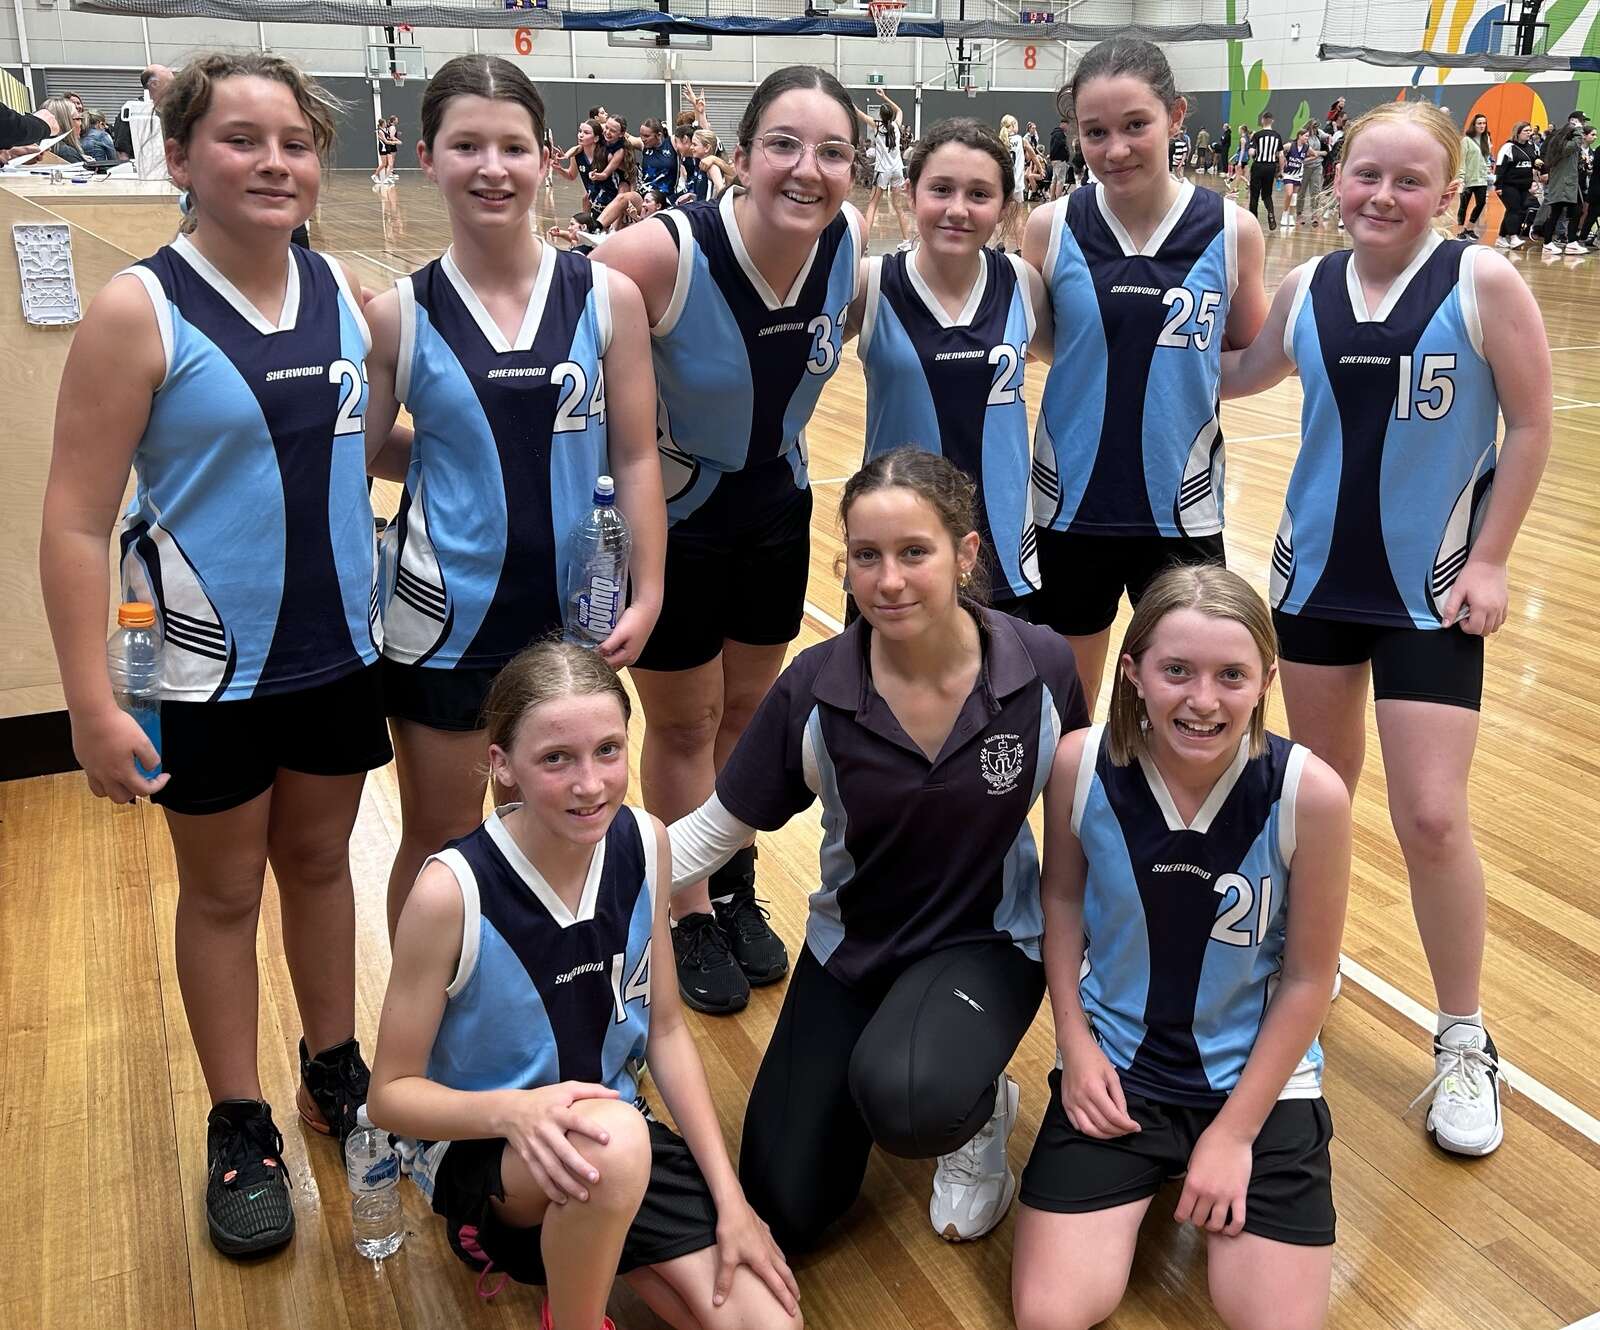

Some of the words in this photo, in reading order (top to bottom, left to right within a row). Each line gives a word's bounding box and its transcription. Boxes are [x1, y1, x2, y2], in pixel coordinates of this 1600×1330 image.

[514, 27, 532, 56] 6
[1024, 45, 1036, 69] 8
[758, 322, 804, 337] SHERWOOD
[1110, 285, 1161, 296] SHERWOOD
[1156, 286, 1223, 351] 25
[935, 350, 985, 361] SHERWOOD
[1339, 355, 1391, 365] SHERWOOD
[1395, 353, 1457, 421] 15
[266, 365, 324, 382] SHERWOOD
[328, 358, 369, 437] 2
[487, 367, 547, 379] SHERWOOD
[550, 360, 606, 434] 24
[1152, 863, 1212, 880] SHERWOOD
[1209, 872, 1272, 948] 21
[610, 936, 652, 1025] 14
